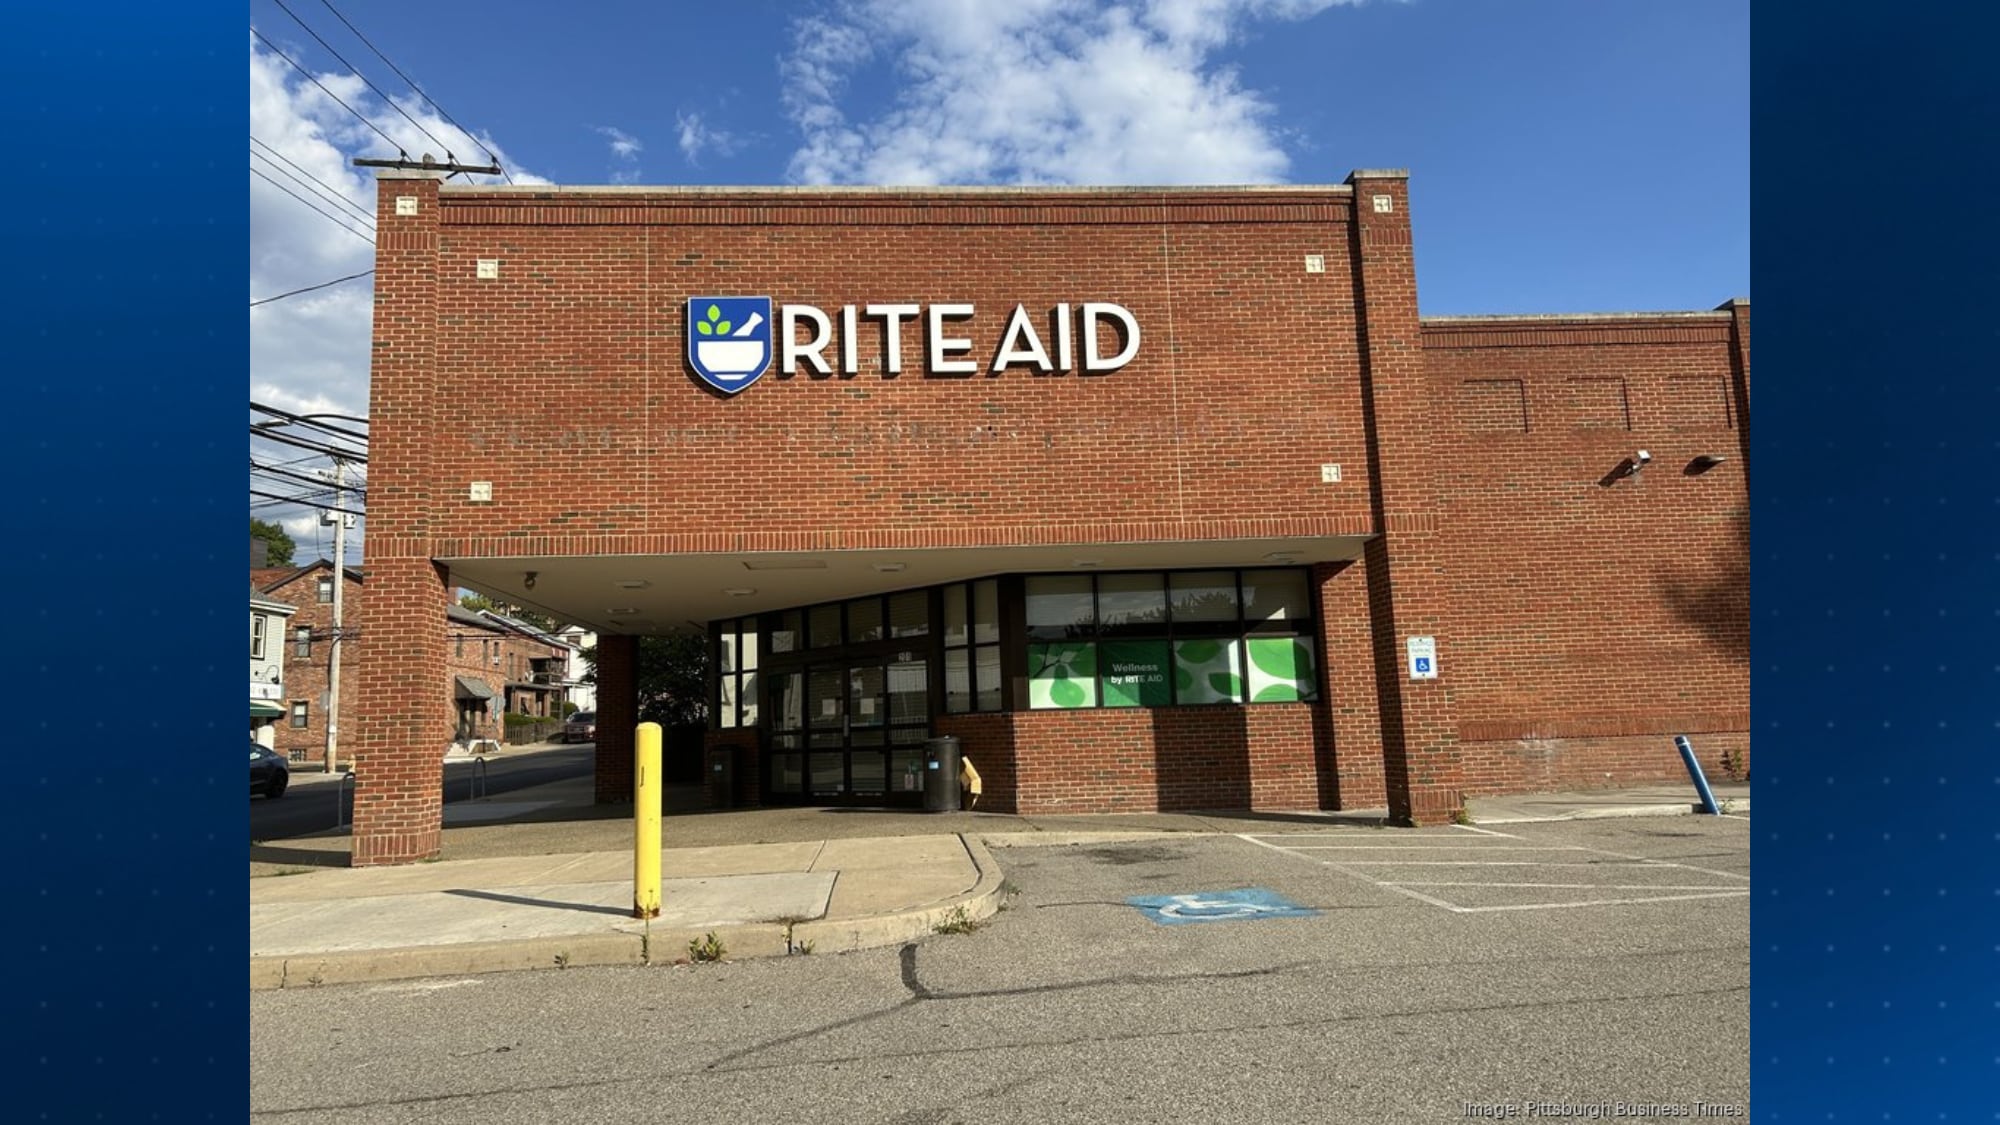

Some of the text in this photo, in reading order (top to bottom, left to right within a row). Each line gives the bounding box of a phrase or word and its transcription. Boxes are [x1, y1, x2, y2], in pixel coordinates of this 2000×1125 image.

[781, 302, 1141, 374] RITE AID
[1112, 663, 1158, 672] Wellness
[1111, 674, 1164, 685] by RITE AID
